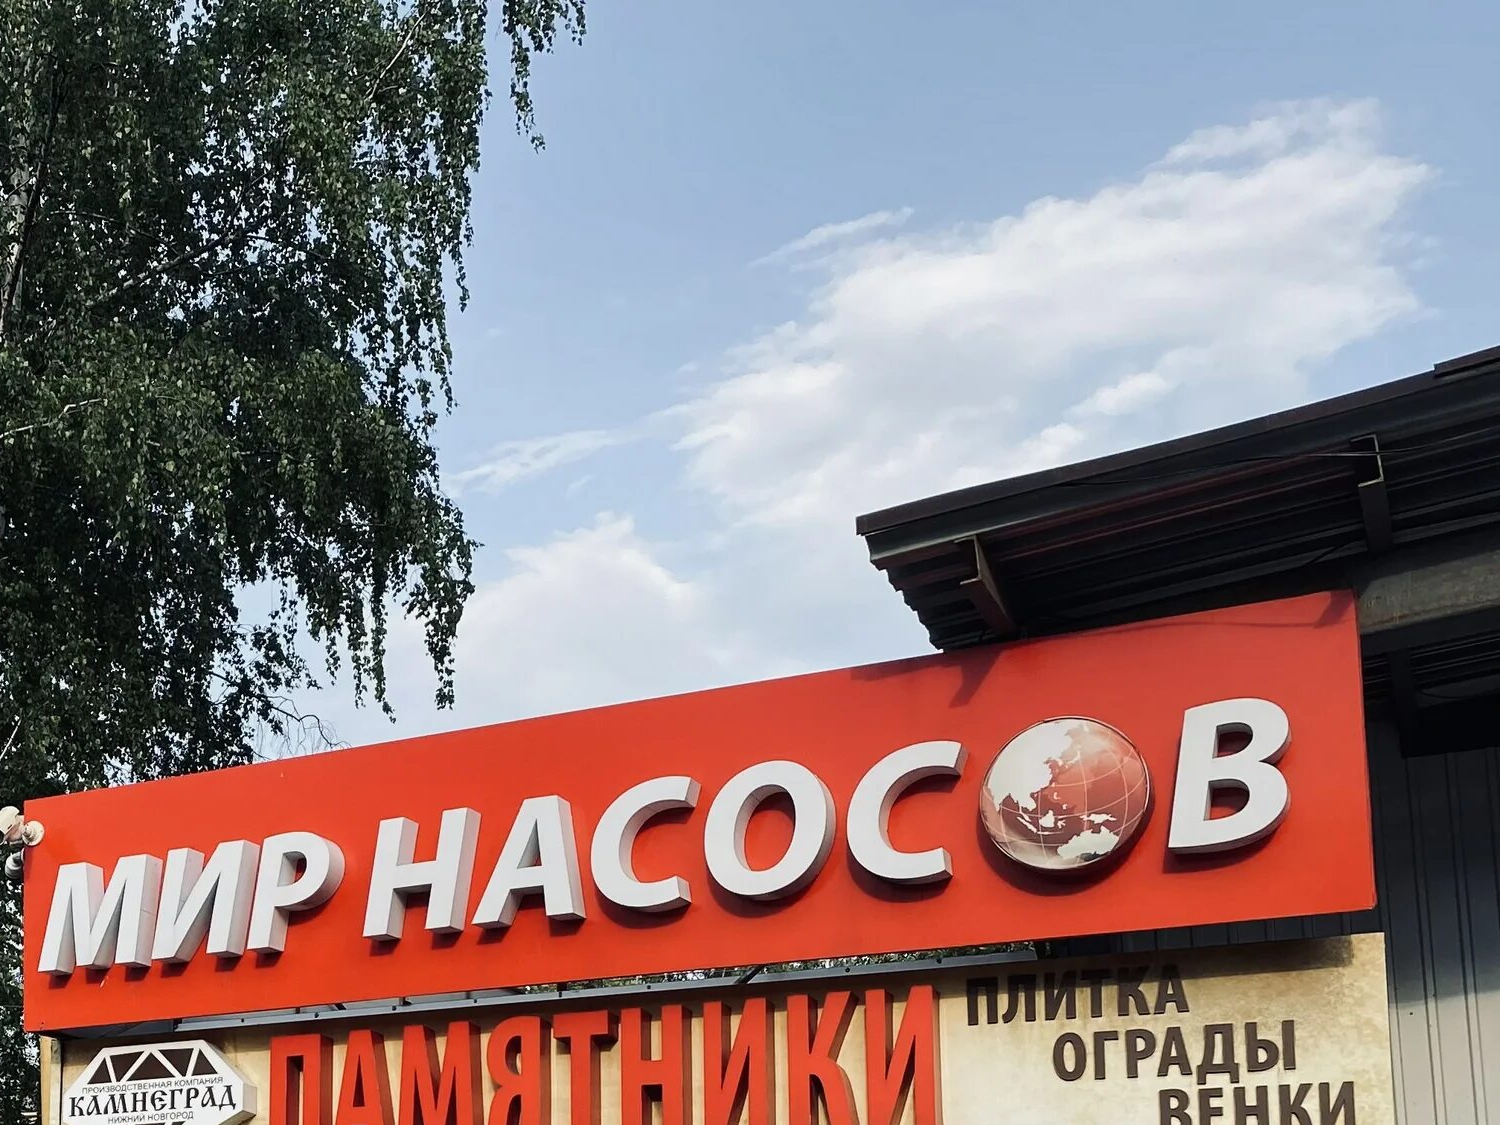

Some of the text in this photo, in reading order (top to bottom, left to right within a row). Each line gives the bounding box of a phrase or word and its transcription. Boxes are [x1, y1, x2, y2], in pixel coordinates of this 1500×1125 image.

[37, 830, 345, 976] МИР
[966, 963, 1190, 1026] ПЛИТКА
[1052, 1019, 1297, 1085] ОГРАДЫ
[69, 1084, 237, 1117] КАМНЕГРАД
[82, 1076, 224, 1094] ПРОИЗВОДСТВЕННАЯ КОМПАНИЯ
[108, 1111, 194, 1124] НИЖНИЙ НОВГОРОД
